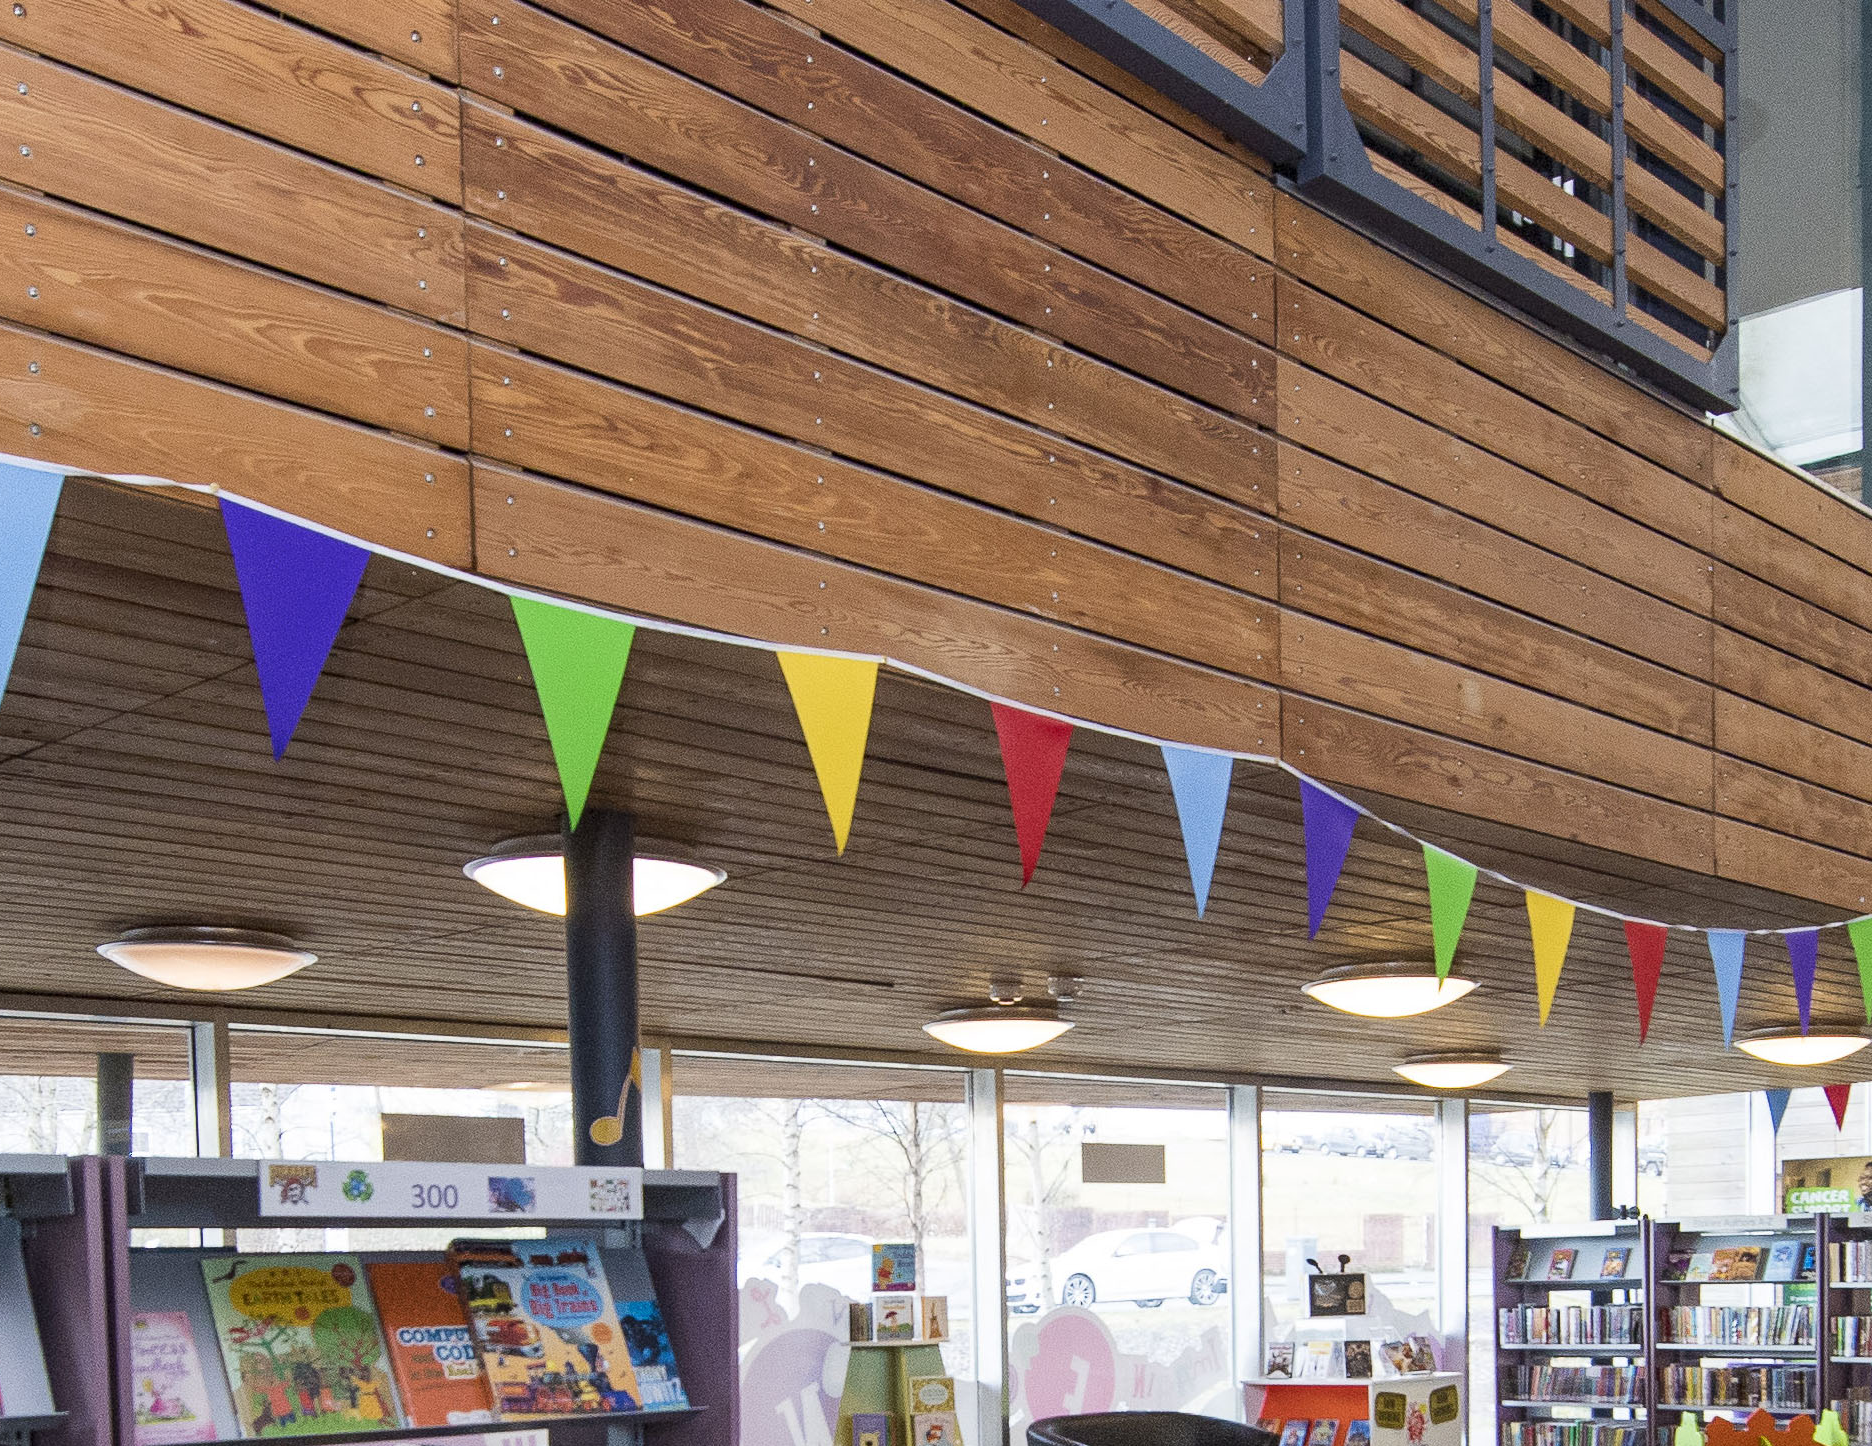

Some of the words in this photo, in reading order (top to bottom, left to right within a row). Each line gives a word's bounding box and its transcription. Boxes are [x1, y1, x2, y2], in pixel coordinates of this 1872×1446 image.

[412, 1184, 459, 1209] 300
[1790, 1189, 1850, 1205] CANCER
[398, 1328, 468, 1344] COMPU
